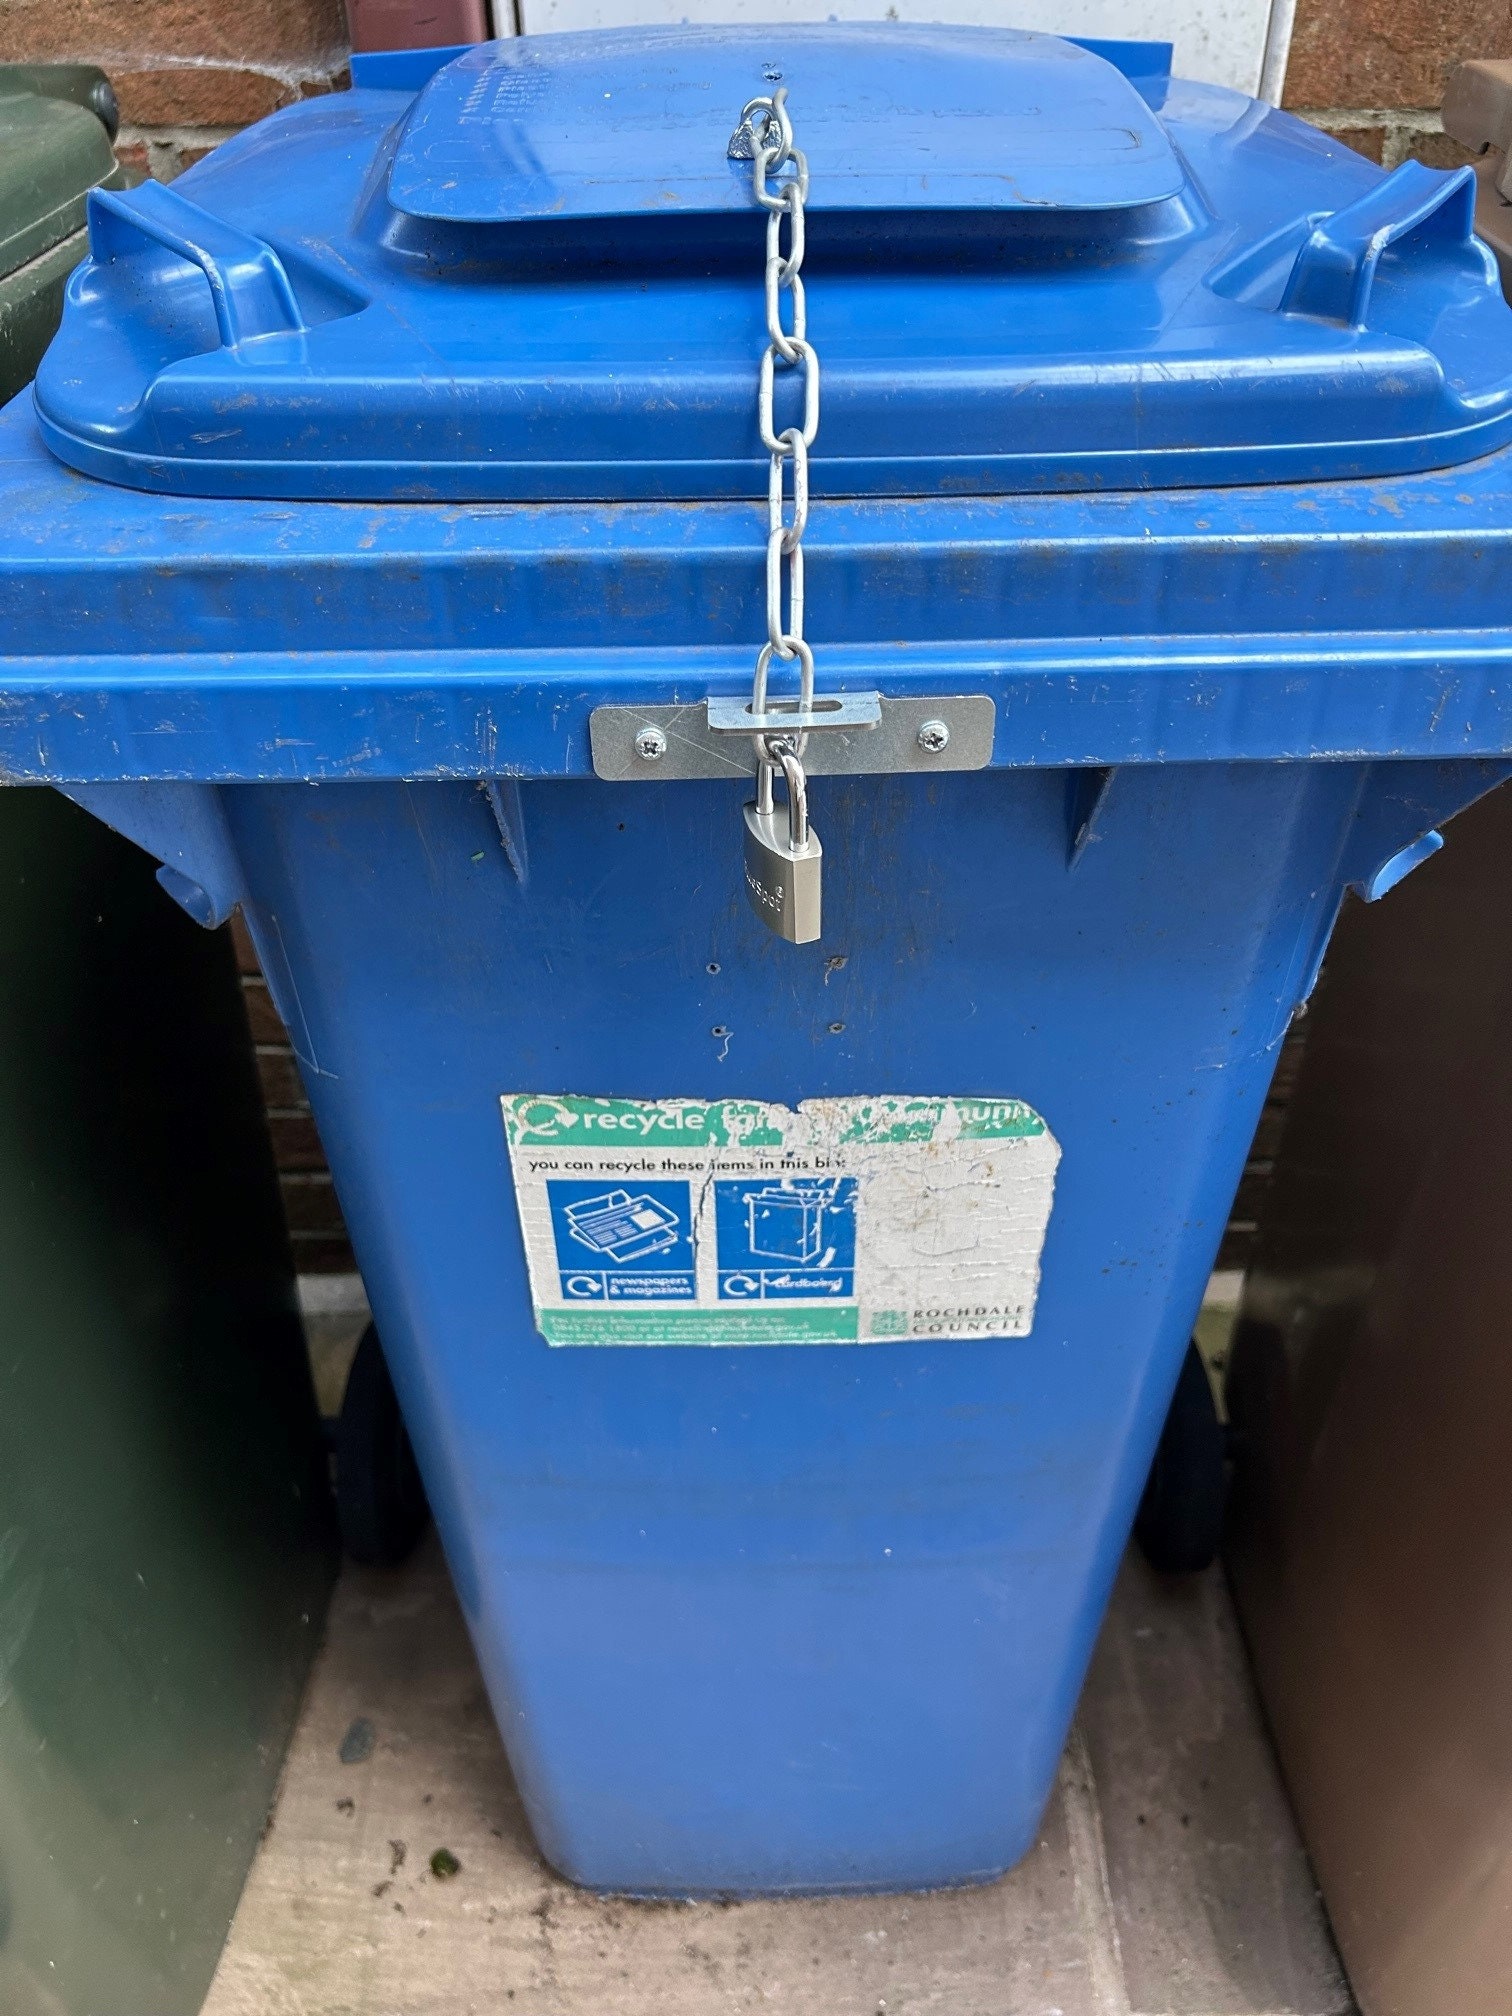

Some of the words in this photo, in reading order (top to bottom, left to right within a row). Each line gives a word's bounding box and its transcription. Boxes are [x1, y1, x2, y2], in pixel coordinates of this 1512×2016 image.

[584, 1109, 705, 1135] recycle
[529, 1160, 558, 1172] you
[565, 1160, 593, 1170] can
[600, 1158, 655, 1172] recycle
[661, 1158, 704, 1170] these
[760, 1158, 774, 1169] in
[611, 1277, 689, 1286] newspapers
[609, 1285, 620, 1295] &
[623, 1285, 693, 1297] magazines
[913, 1305, 1025, 1318] ROCHDALE
[912, 1321, 1022, 1333] COUNCIL
